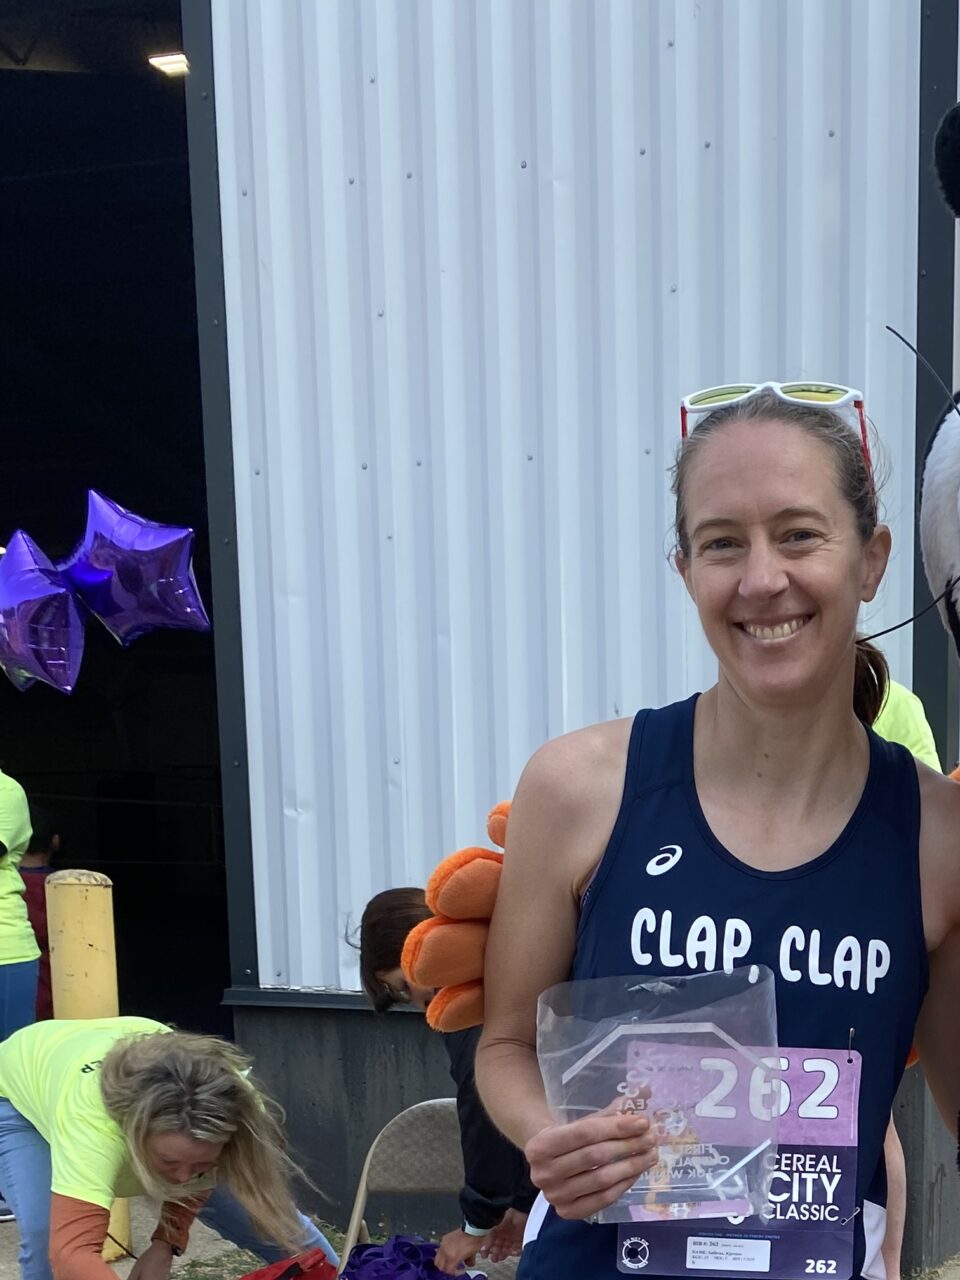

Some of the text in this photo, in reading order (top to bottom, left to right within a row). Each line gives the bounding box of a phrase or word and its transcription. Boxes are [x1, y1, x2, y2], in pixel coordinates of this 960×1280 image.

[631, 907, 891, 994] CLAP, CLAP
[694, 1056, 840, 1122] 262
[766, 1153, 841, 1173] CEREAL
[765, 1170, 842, 1204] CITY
[762, 1202, 840, 1222] CLASSIC
[805, 1259, 837, 1274] 262
